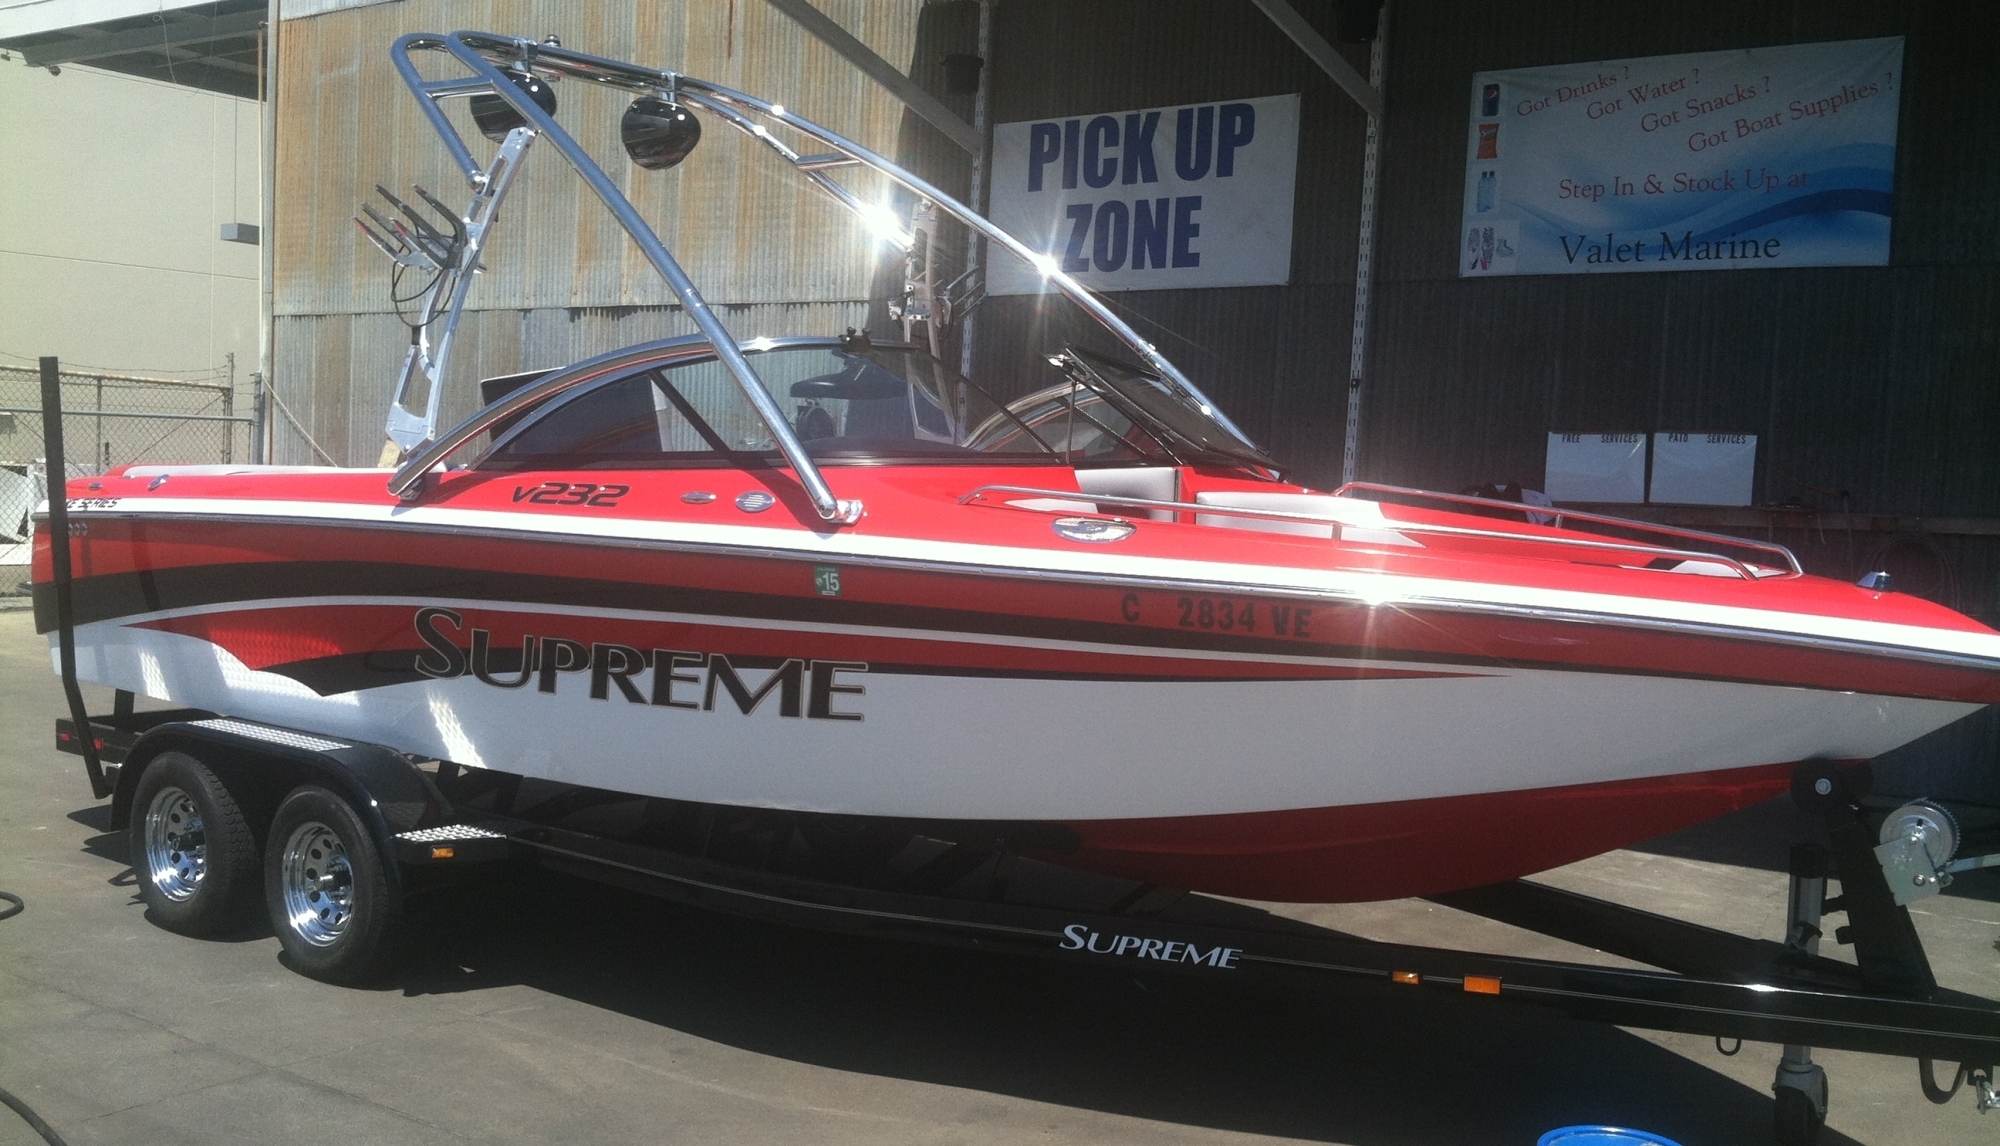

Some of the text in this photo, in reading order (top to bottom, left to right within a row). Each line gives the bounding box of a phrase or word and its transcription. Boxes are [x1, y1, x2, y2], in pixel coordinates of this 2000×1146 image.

[1517, 97, 1551, 116] Got
[1556, 74, 1617, 103] Drinks
[1587, 68, 1699, 119] Got Water ?
[1641, 76, 1770, 132] Got Snacks ?
[1688, 72, 1893, 152] Got Boat Supplies ?
[1027, 103, 1256, 192] PICK UP
[1559, 168, 1809, 202] Step In & Stock Up at
[1062, 195, 1202, 273] ZONE
[1559, 231, 1781, 264] Valet Marine
[1562, 434, 1638, 444] FREE SERVICES
[1668, 433, 1747, 444] PAID SERVICES
[512, 482, 630, 508] V232
[822, 572, 840, 591] 15
[1122, 593, 1312, 637] C 2834 VE
[414, 606, 868, 722] SUPREME
[1059, 924, 1243, 969] SUPREME
